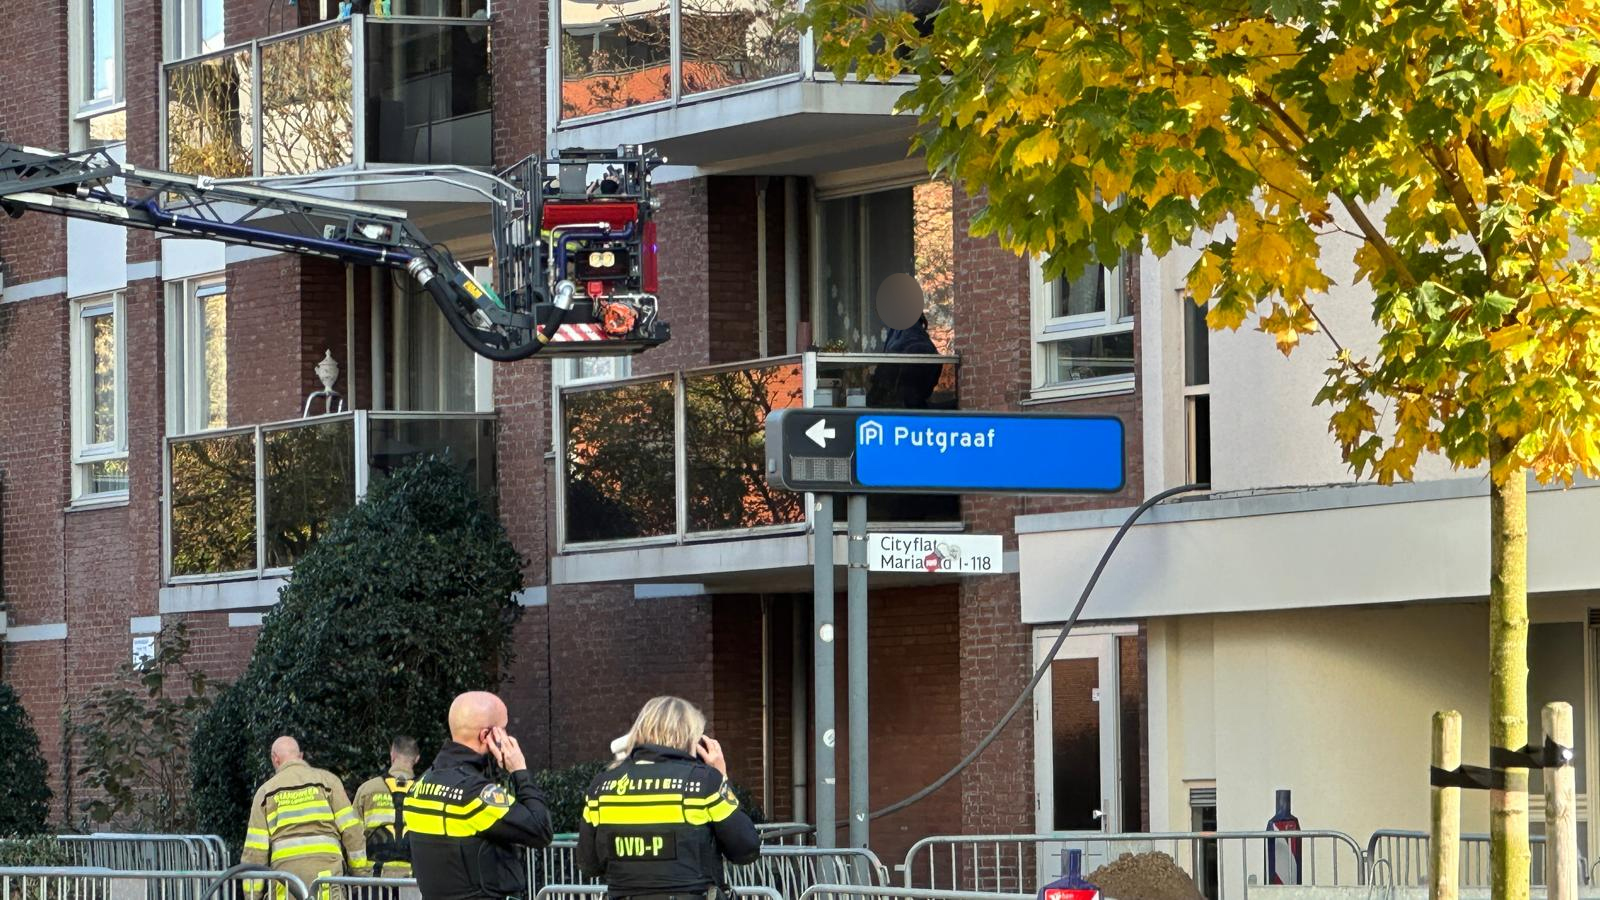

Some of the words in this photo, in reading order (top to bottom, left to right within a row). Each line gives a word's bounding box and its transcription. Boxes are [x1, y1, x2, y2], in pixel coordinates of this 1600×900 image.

[894, 426, 996, 452] Putgraaf
[881, 536, 937, 554] Cityflat
[610, 775, 672, 794] POLITIE
[615, 836, 663, 857] OVD-P
